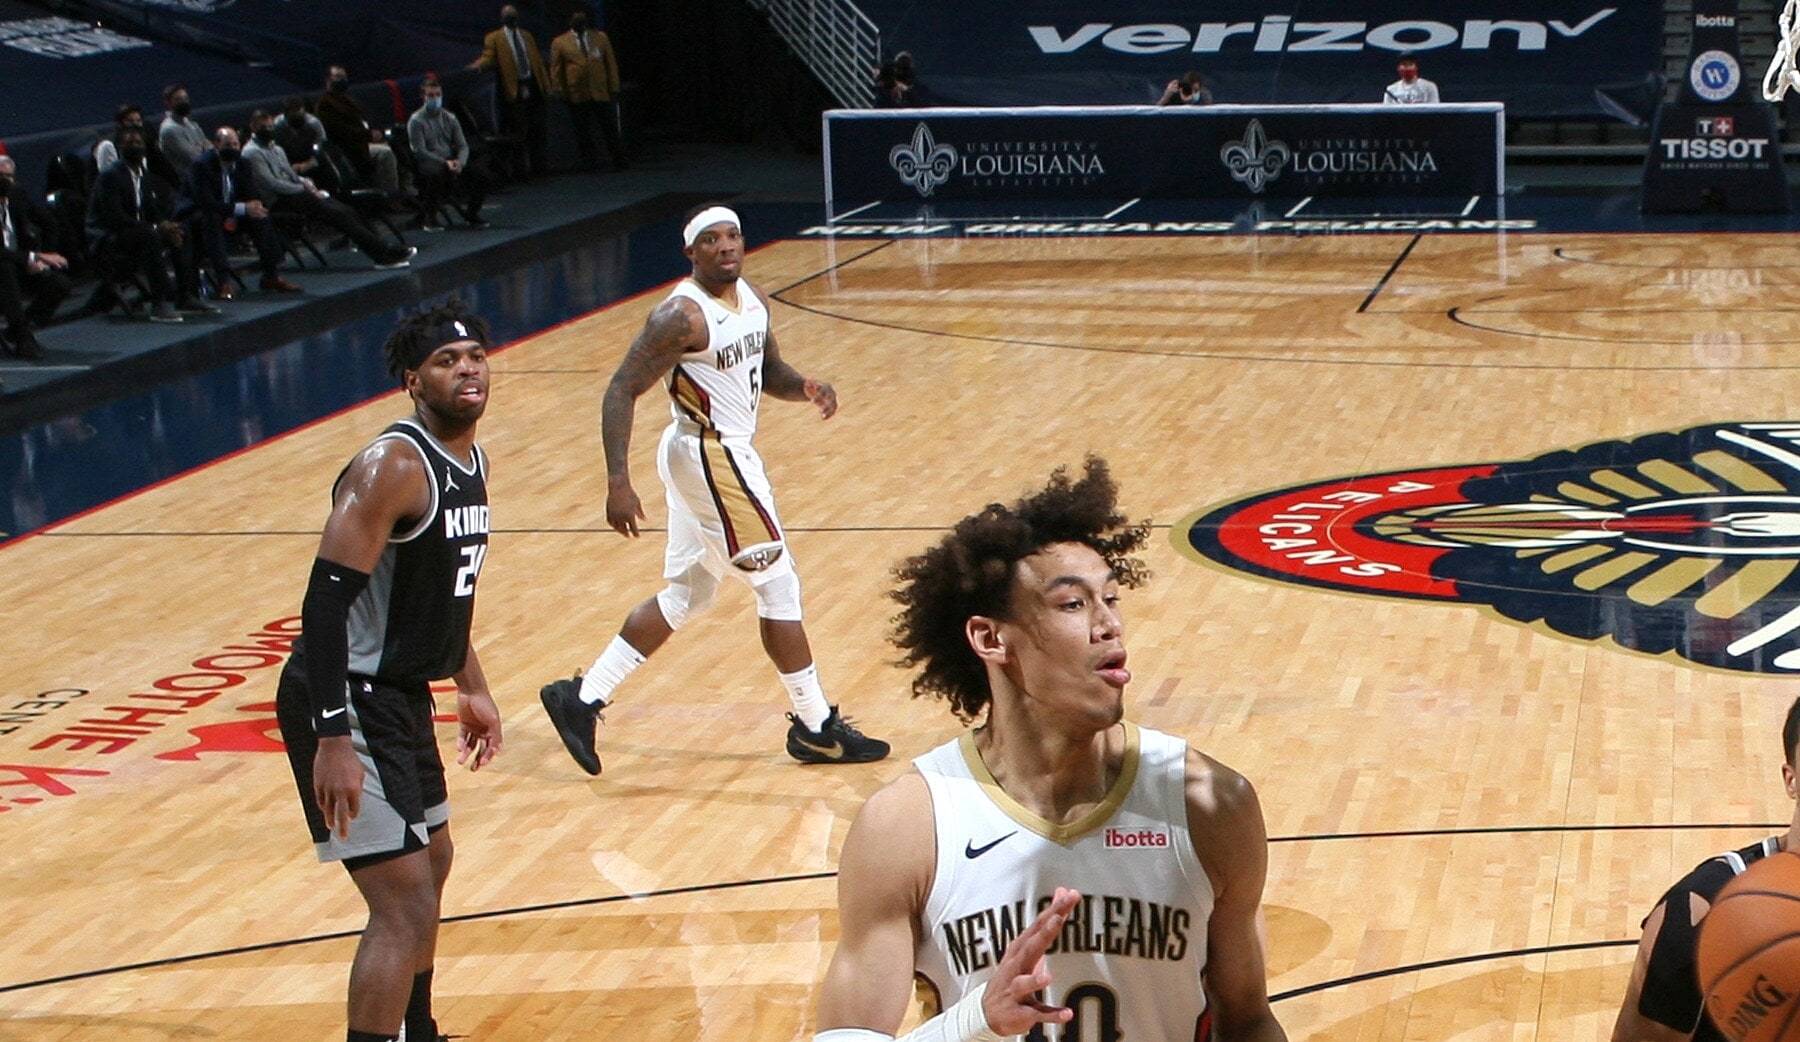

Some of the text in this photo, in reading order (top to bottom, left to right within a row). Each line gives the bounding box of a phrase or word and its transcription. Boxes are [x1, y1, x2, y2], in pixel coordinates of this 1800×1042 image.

[1696, 14, 1735, 27] ibotta
[1028, 16, 1549, 53] verizon
[967, 142, 1082, 152] UNIVERSITY
[1660, 139, 1769, 159] TISSOT
[961, 154, 1105, 176] LOUISIANA
[1293, 151, 1438, 173] LOUISIANA
[716, 338, 744, 370] NEW
[444, 505, 489, 539] KING
[1260, 480, 1435, 580] PELICANS
[1105, 829, 1168, 847] ibotta
[942, 899, 1028, 977] NEW
